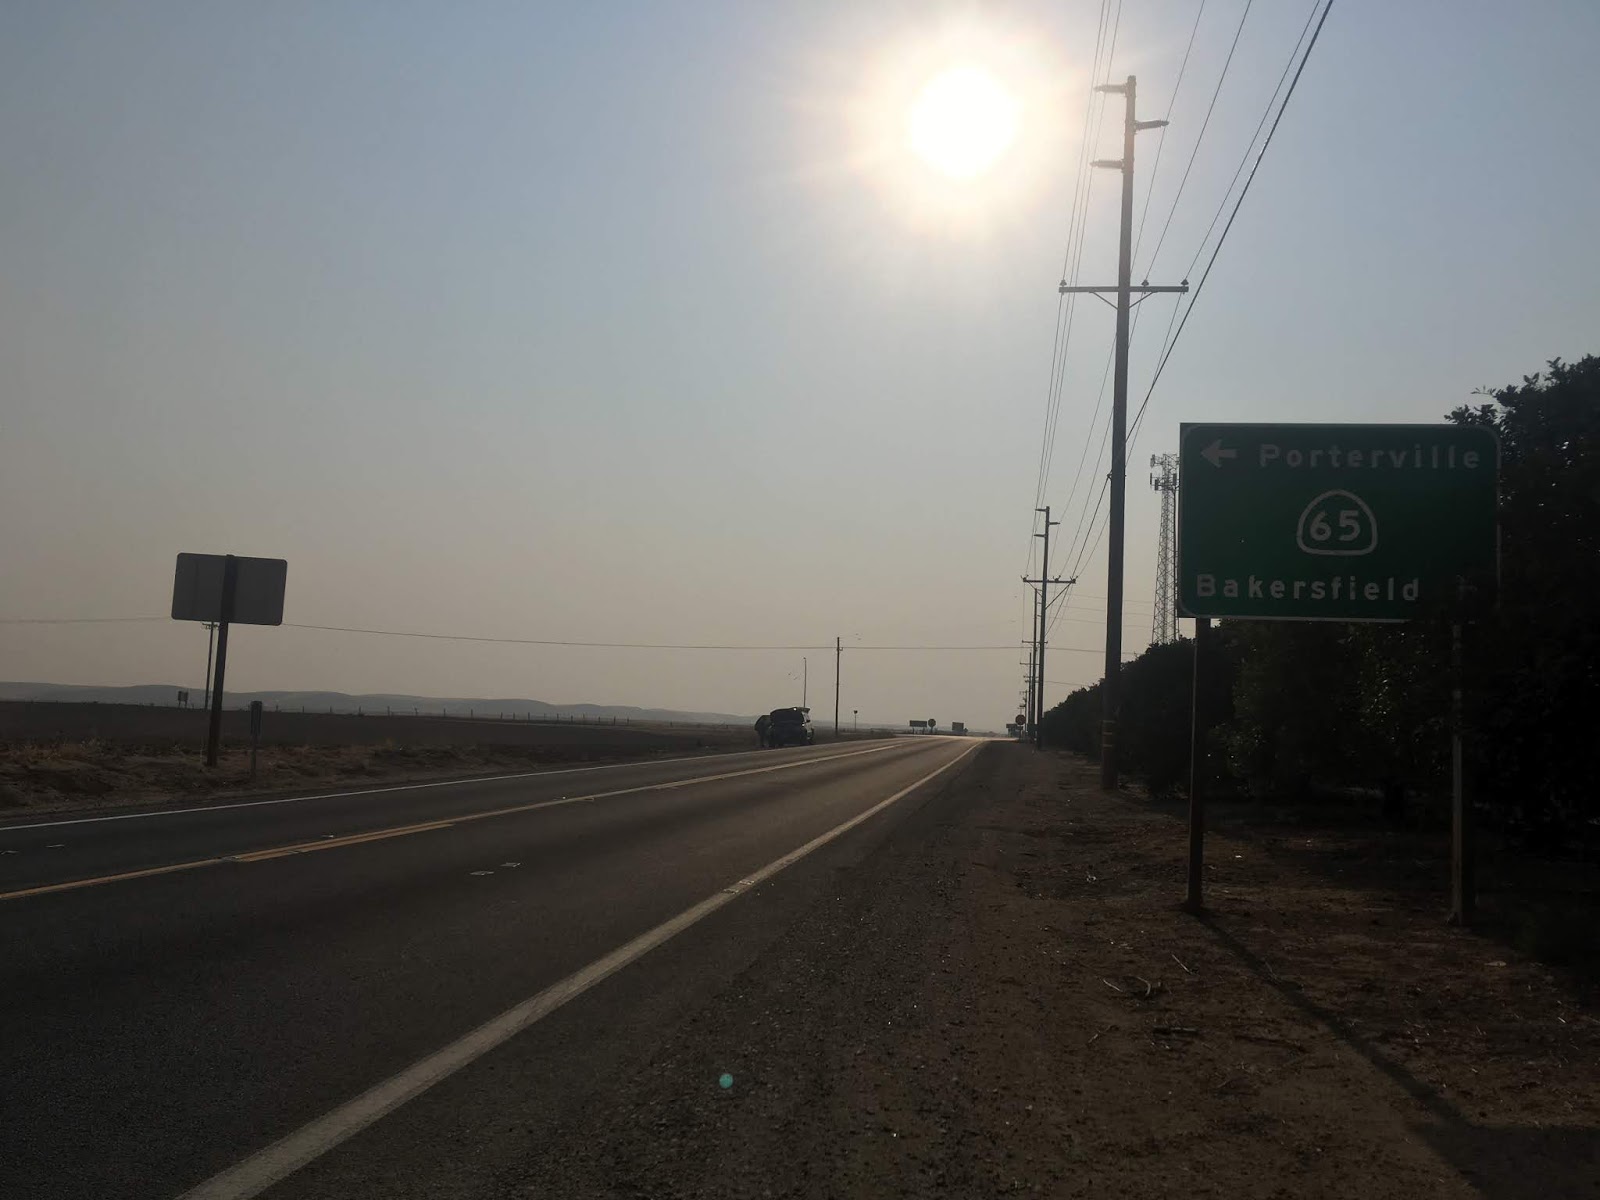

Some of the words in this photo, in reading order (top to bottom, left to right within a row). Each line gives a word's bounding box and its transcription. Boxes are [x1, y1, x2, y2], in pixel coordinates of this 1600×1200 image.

[1260, 443, 1480, 469] Porterville
[1309, 510, 1361, 542] 65
[1196, 574, 1419, 601] Bakersfield
